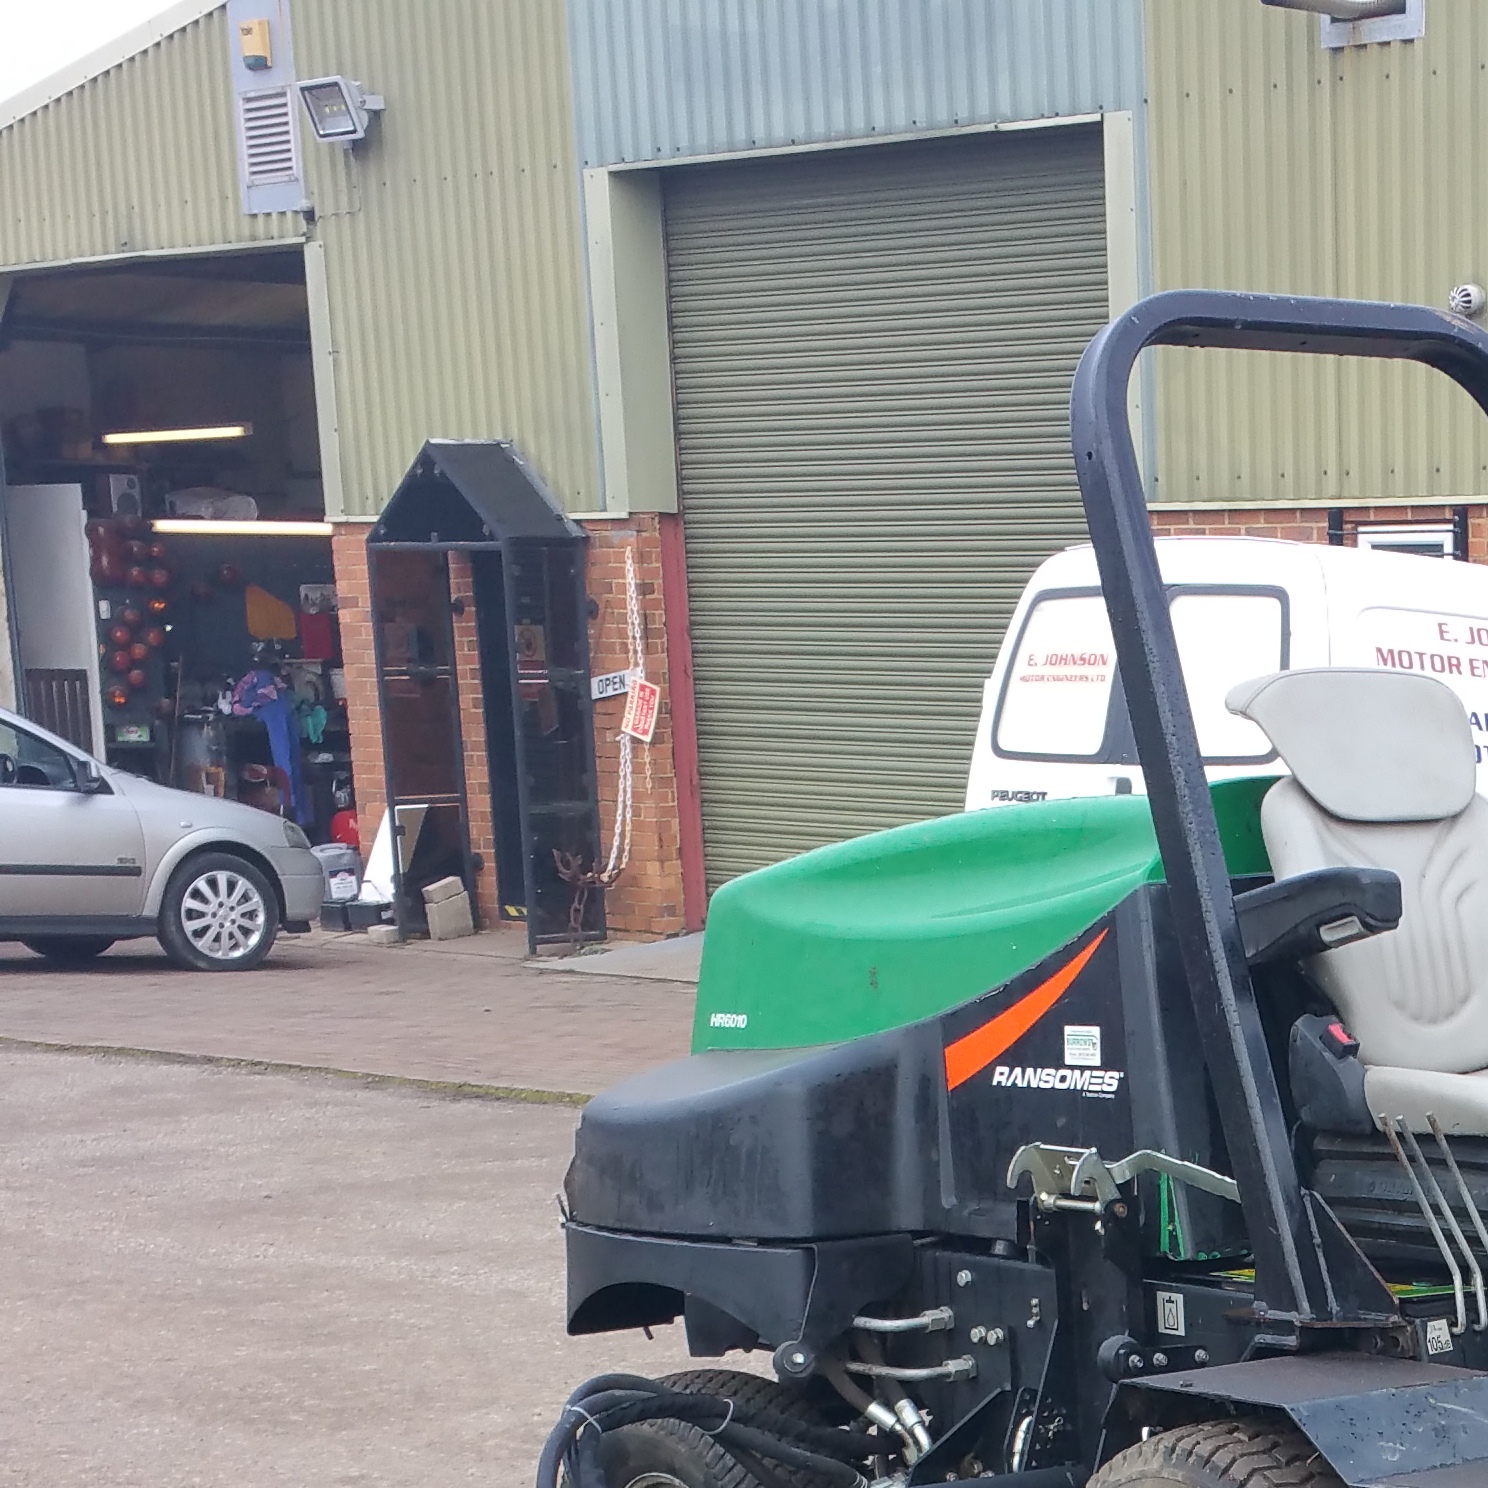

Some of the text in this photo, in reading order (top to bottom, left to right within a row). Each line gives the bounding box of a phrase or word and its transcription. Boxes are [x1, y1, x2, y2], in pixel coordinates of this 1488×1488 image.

[1437, 622, 1458, 643] E.
[1041, 652, 1109, 667] JOHNSON
[1375, 646, 1463, 676] MOTOR
[597, 674, 626, 694] OPEN
[991, 789, 1048, 803] PEUGEOT
[710, 1013, 748, 1029] HR6010
[992, 1066, 1120, 1092] RANSOMES
